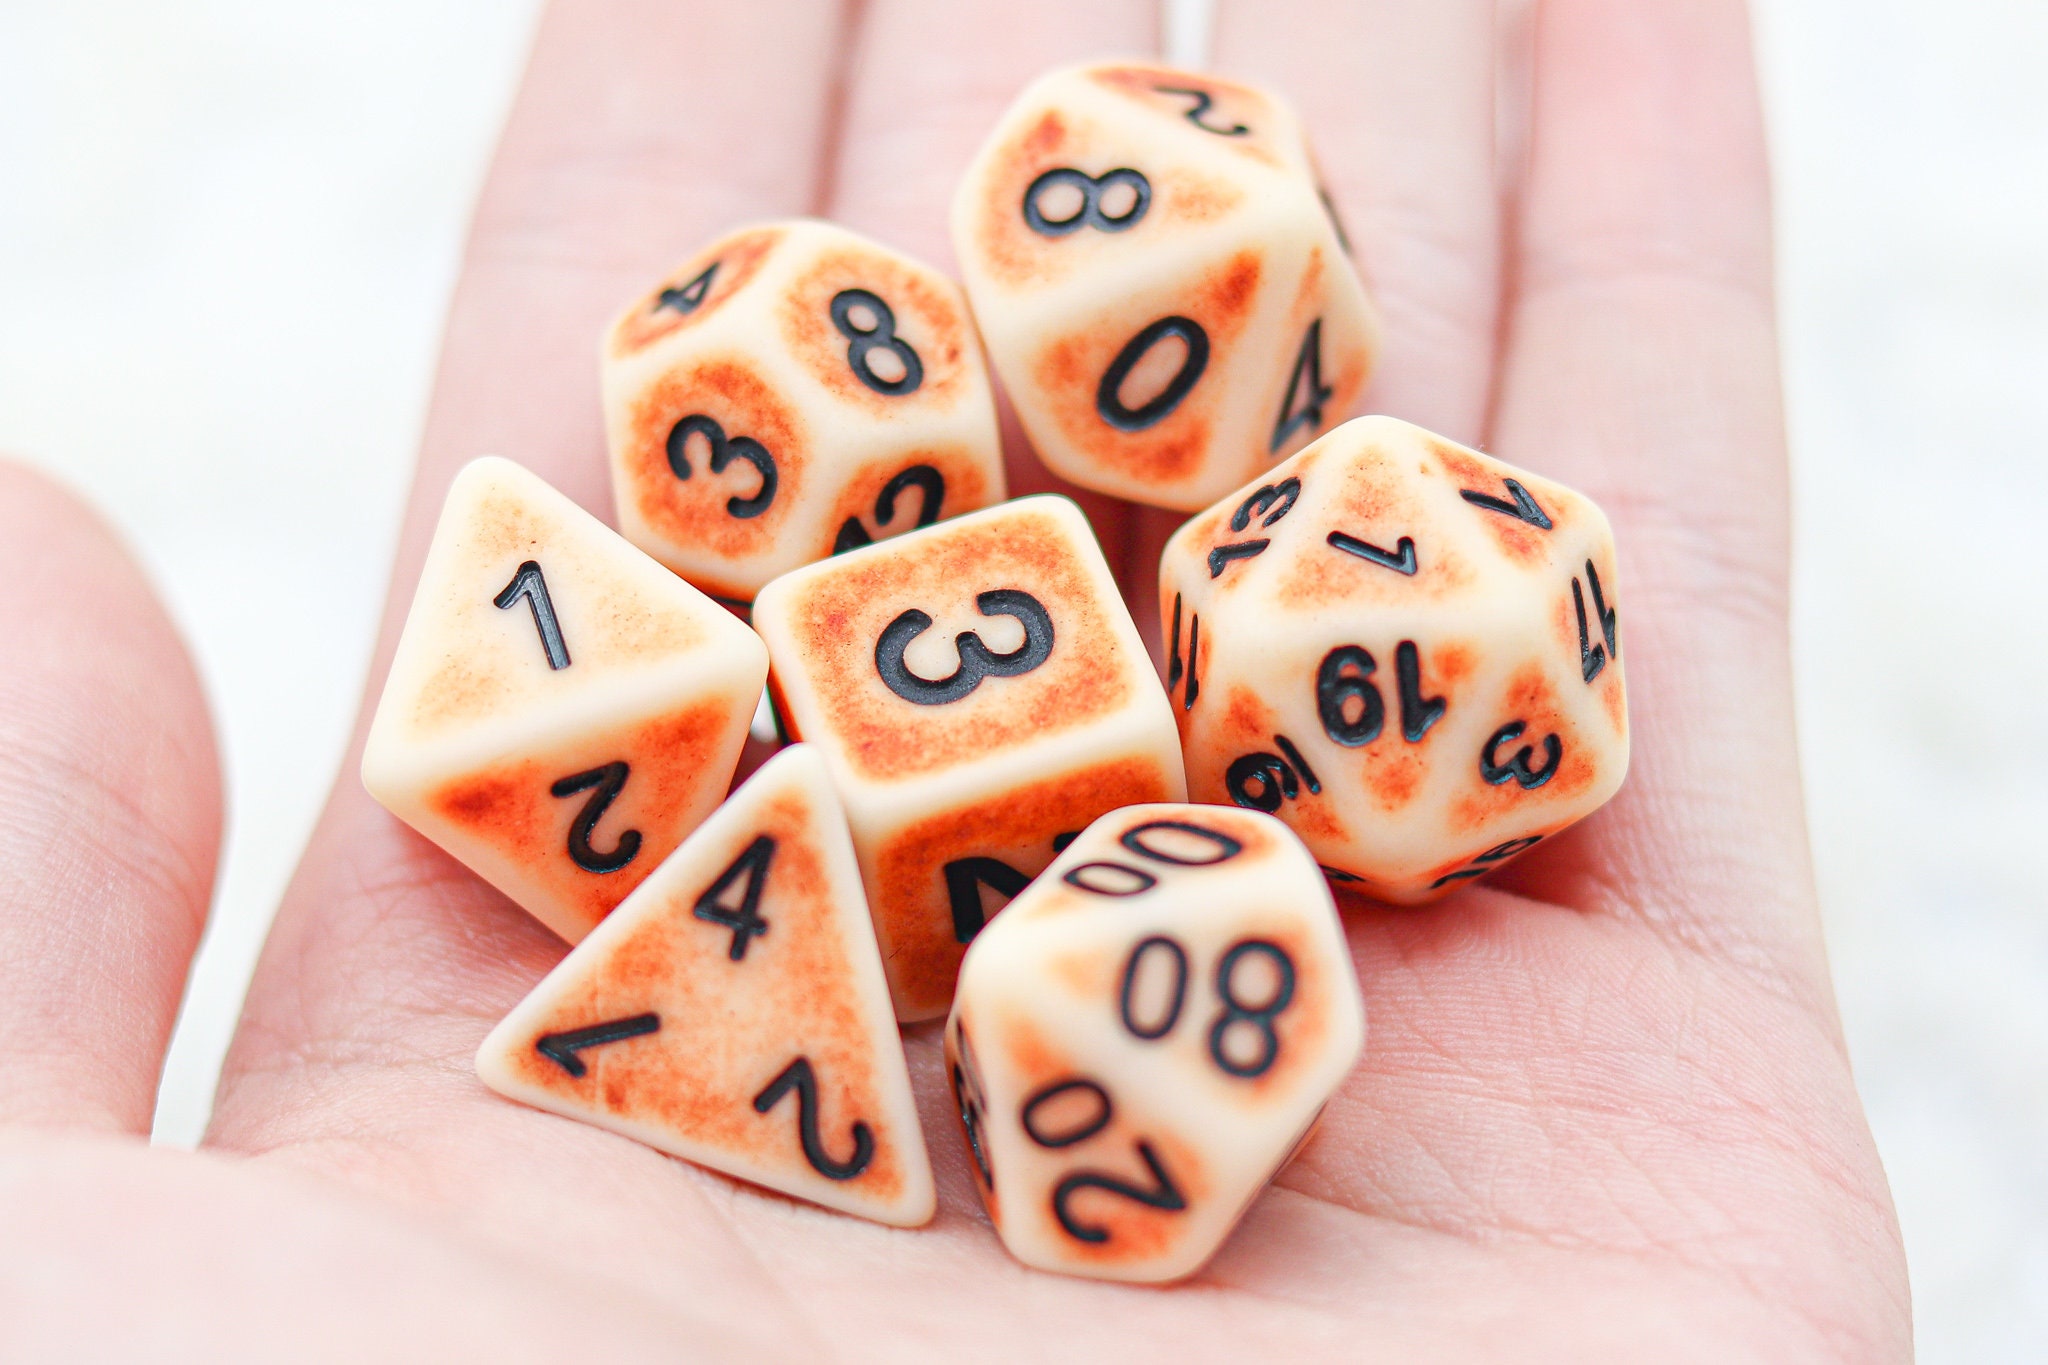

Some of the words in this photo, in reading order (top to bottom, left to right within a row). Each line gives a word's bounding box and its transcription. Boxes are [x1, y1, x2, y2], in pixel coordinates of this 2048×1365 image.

[1154, 85, 1250, 138] 2
[1022, 167, 1152, 237] 8
[654, 261, 720, 315] 4
[829, 287, 924, 397] 8
[1096, 314, 1211, 432] 0
[1270, 317, 1333, 455] 4
[665, 413, 778, 520] 3
[1206, 476, 1302, 580] 13
[493, 560, 572, 672] 1
[874, 588, 1055, 706] 3
[1168, 591, 1200, 713] 11
[1570, 558, 1617, 686] 17
[1315, 639, 1448, 749] 19
[1478, 718, 1564, 791] 3
[550, 760, 644, 875] 2
[1062, 820, 1244, 898] 00
[693, 835, 778, 961] 4
[534, 1012, 661, 1079] 1
[1119, 936, 1297, 1080] 80
[753, 1056, 875, 1181] 2
[1020, 1077, 1188, 1245] 20
